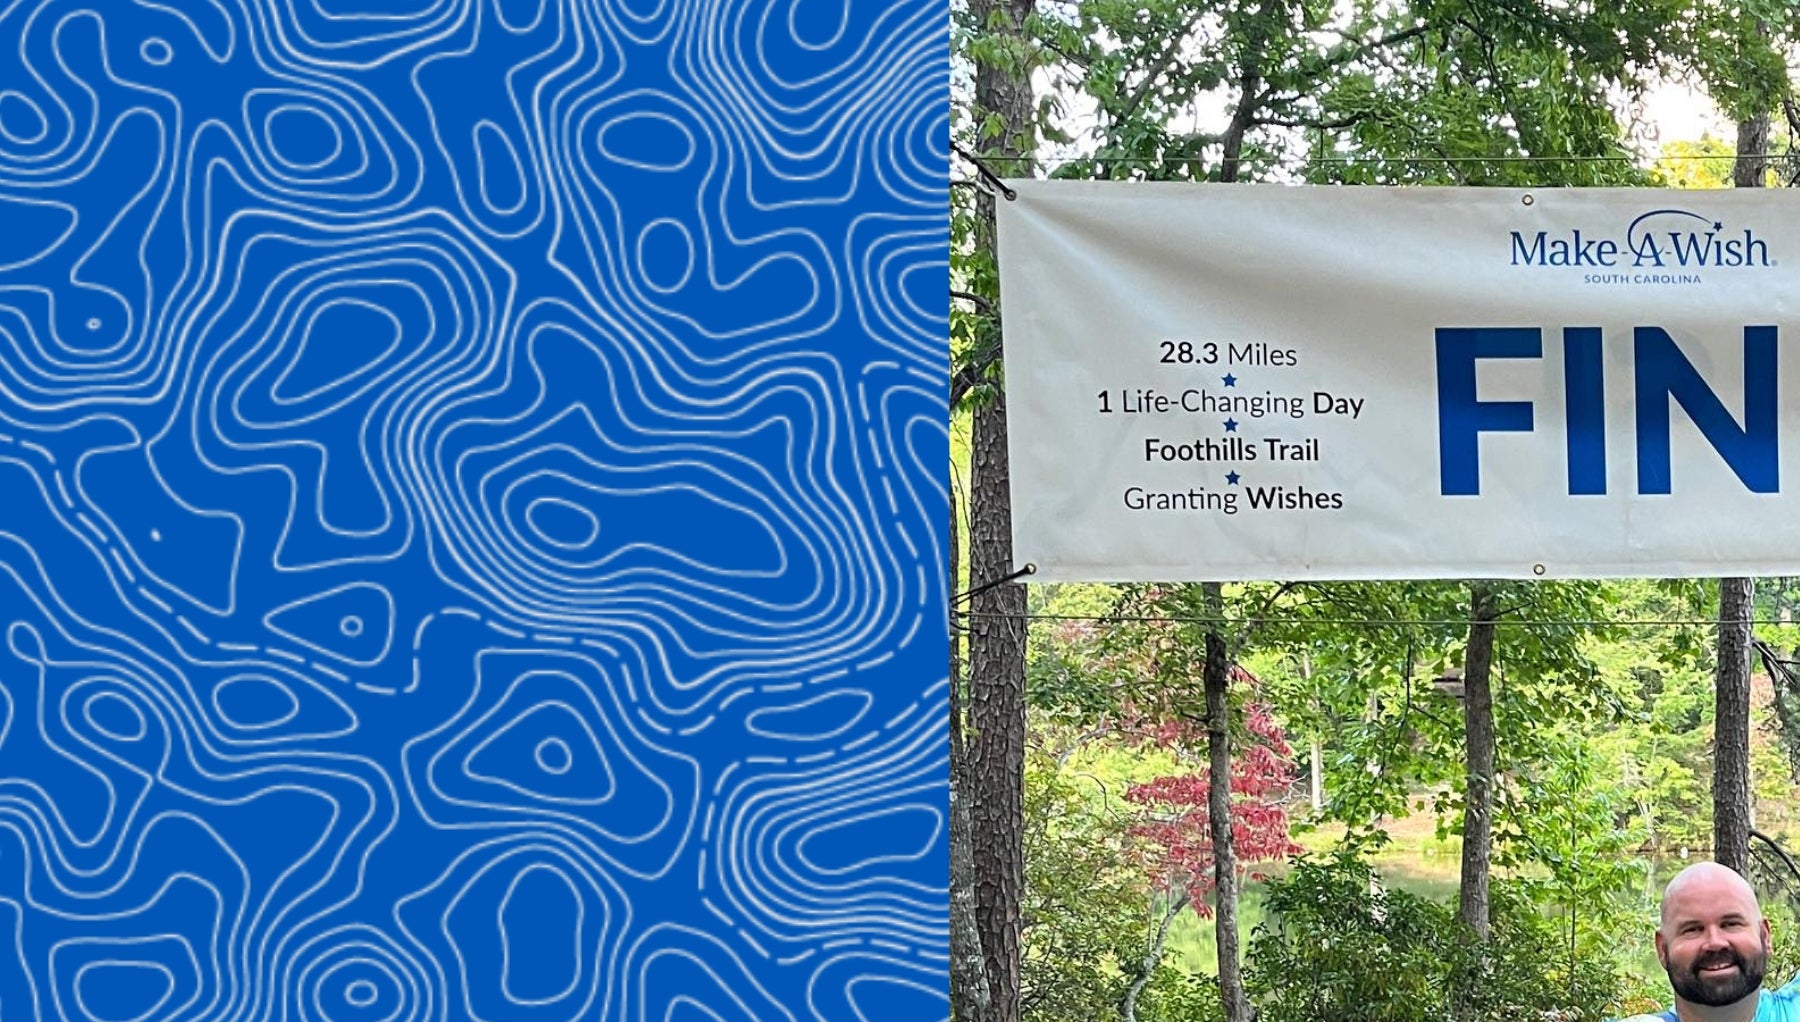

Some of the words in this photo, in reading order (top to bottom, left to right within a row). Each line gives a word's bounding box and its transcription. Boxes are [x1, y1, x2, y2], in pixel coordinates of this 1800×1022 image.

[1509, 213, 1770, 268] Make-A-Wish
[1584, 274, 1630, 285] SOUTH
[1634, 274, 1702, 285] CAROLINA
[1159, 341, 1219, 365] 28.3
[1227, 342, 1298, 367] Miles
[1097, 391, 1113, 414] 1
[1121, 389, 1305, 418] Life-Changing
[1313, 392, 1365, 420] Day
[1144, 438, 1258, 462] Foothills
[1262, 438, 1320, 462] Trail
[1123, 487, 1240, 515] Granting
[1245, 486, 1344, 511] Wishes
